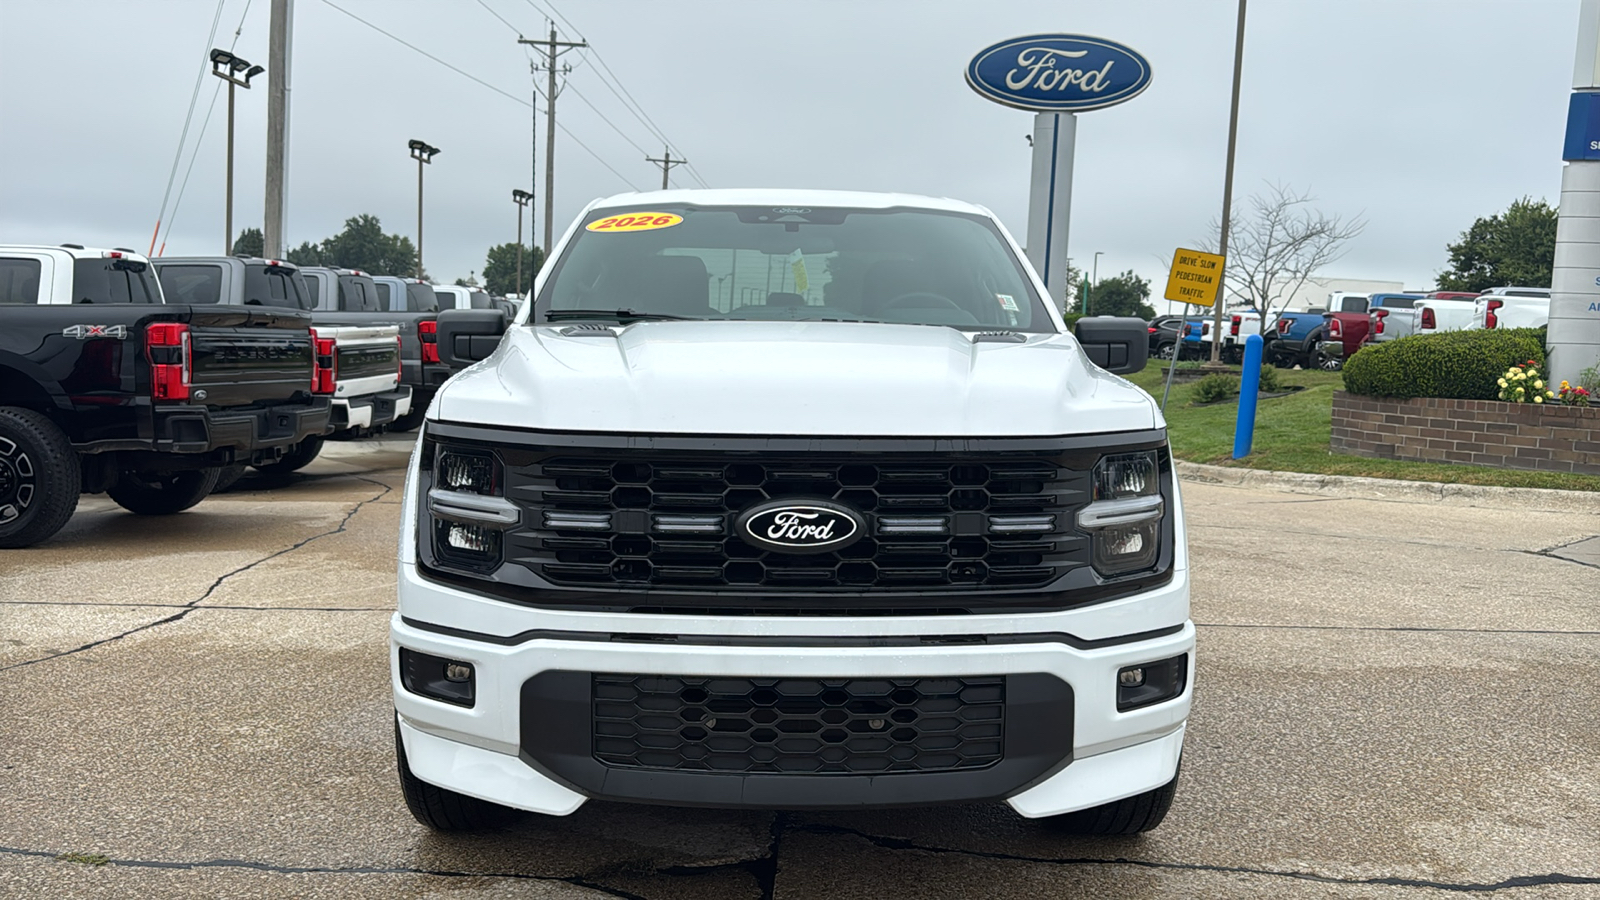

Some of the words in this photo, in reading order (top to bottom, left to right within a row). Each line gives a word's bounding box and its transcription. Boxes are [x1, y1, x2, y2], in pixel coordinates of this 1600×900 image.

[1005, 47, 1115, 93] Ford
[595, 215, 674, 230] 2026
[1179, 256, 1198, 267] DRIVE
[1200, 259, 1216, 269] SLOW
[1175, 271, 1213, 284] PEDESTRIAN
[1179, 286, 1205, 298] TRAFFIC
[767, 511, 836, 539] Ford
